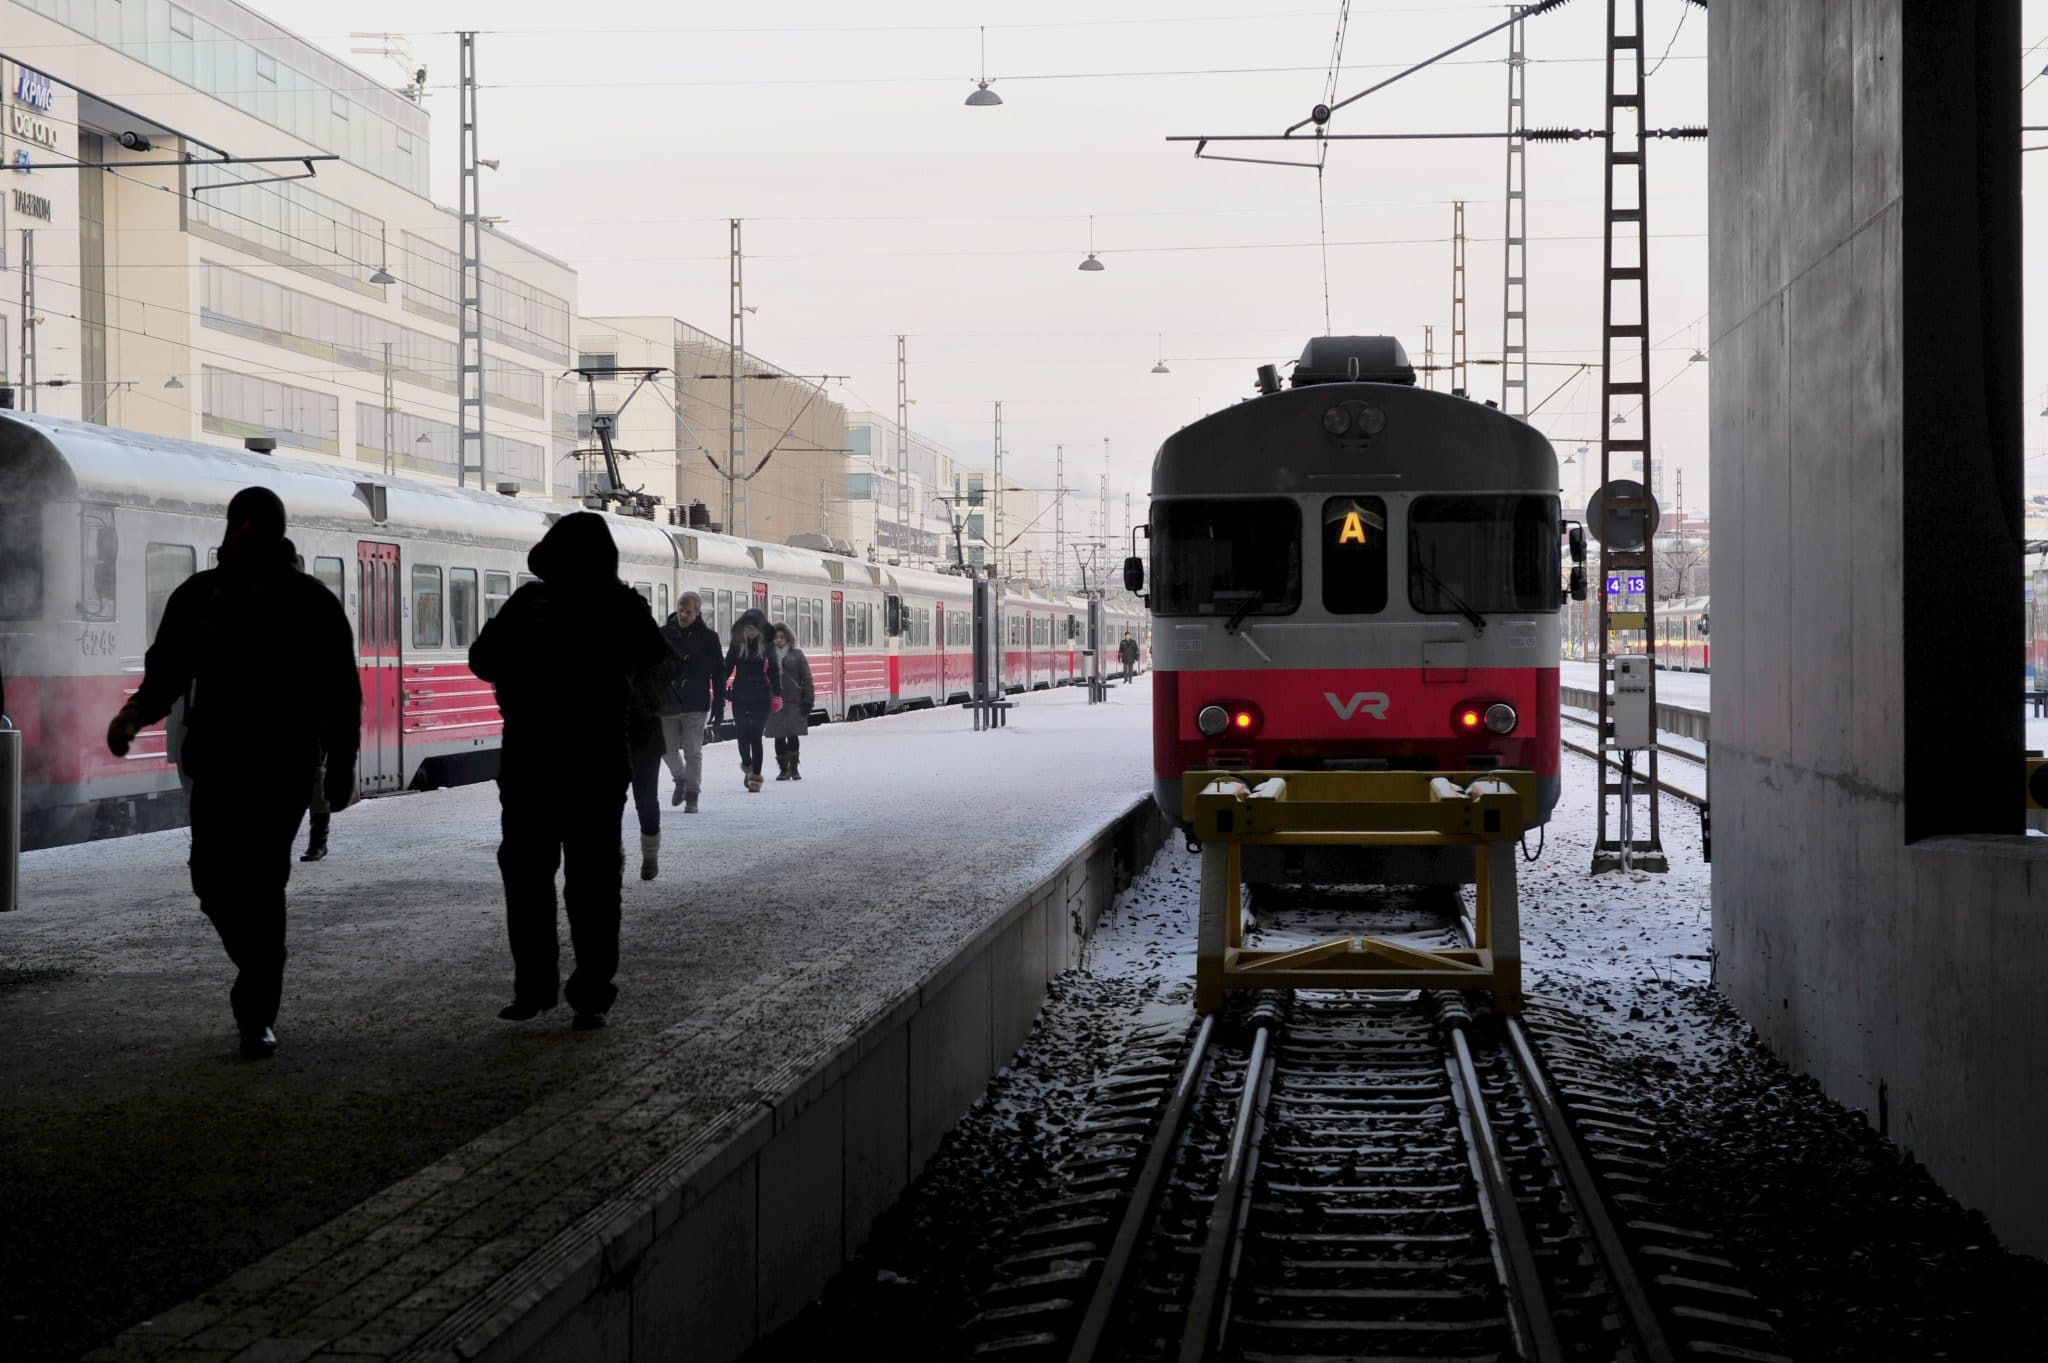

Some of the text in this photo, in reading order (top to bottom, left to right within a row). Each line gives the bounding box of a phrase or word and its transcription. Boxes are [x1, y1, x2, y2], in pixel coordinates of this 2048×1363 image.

[21, 77, 53, 110] KPMG
[1339, 512, 1366, 544] A
[1628, 578, 1644, 591] 13
[1323, 692, 1390, 720] VR
